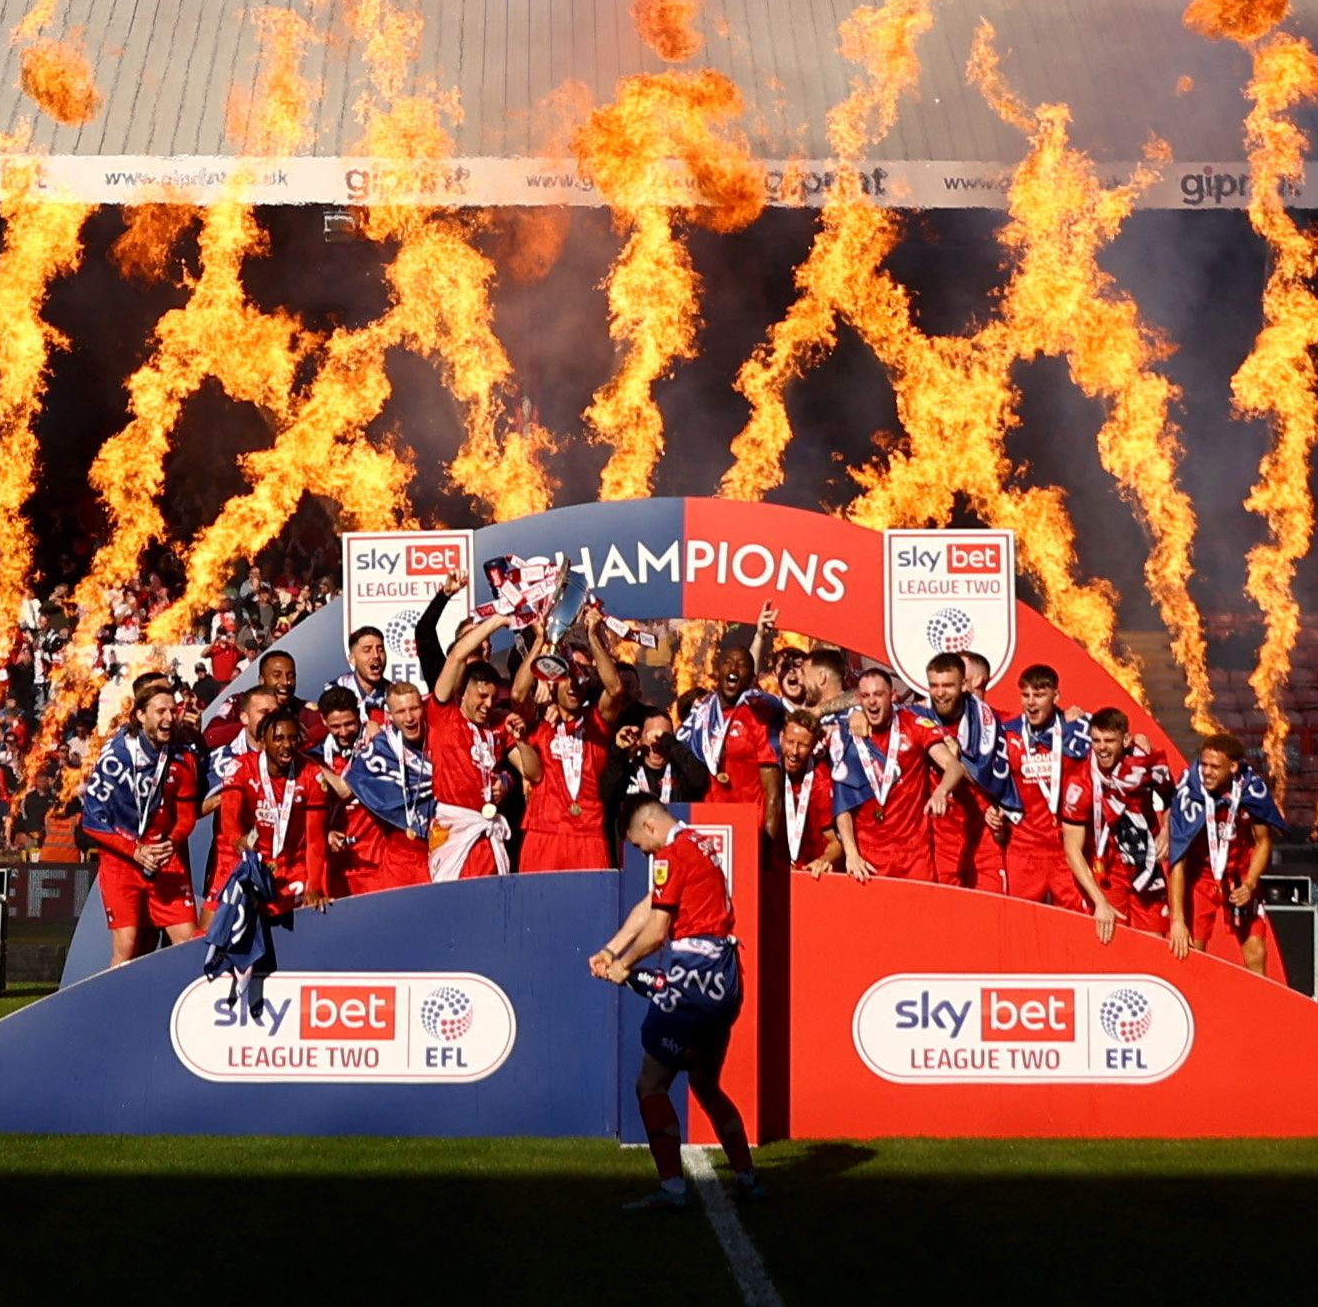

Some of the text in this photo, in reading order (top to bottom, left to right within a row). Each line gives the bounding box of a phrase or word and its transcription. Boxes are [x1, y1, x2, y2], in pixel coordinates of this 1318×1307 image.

[356, 546, 456, 575] sky bet
[897, 545, 997, 573] sky bet
[357, 580, 446, 598] LEAGUE TW
[898, 579, 1002, 595] LEAGUE TWO
[309, 989, 387, 1029] bet
[894, 990, 1067, 1039] sky bet
[227, 1046, 469, 1069] LEAGUE TWO EFL
[910, 1048, 1148, 1070] LEAGUE TWO EFL
